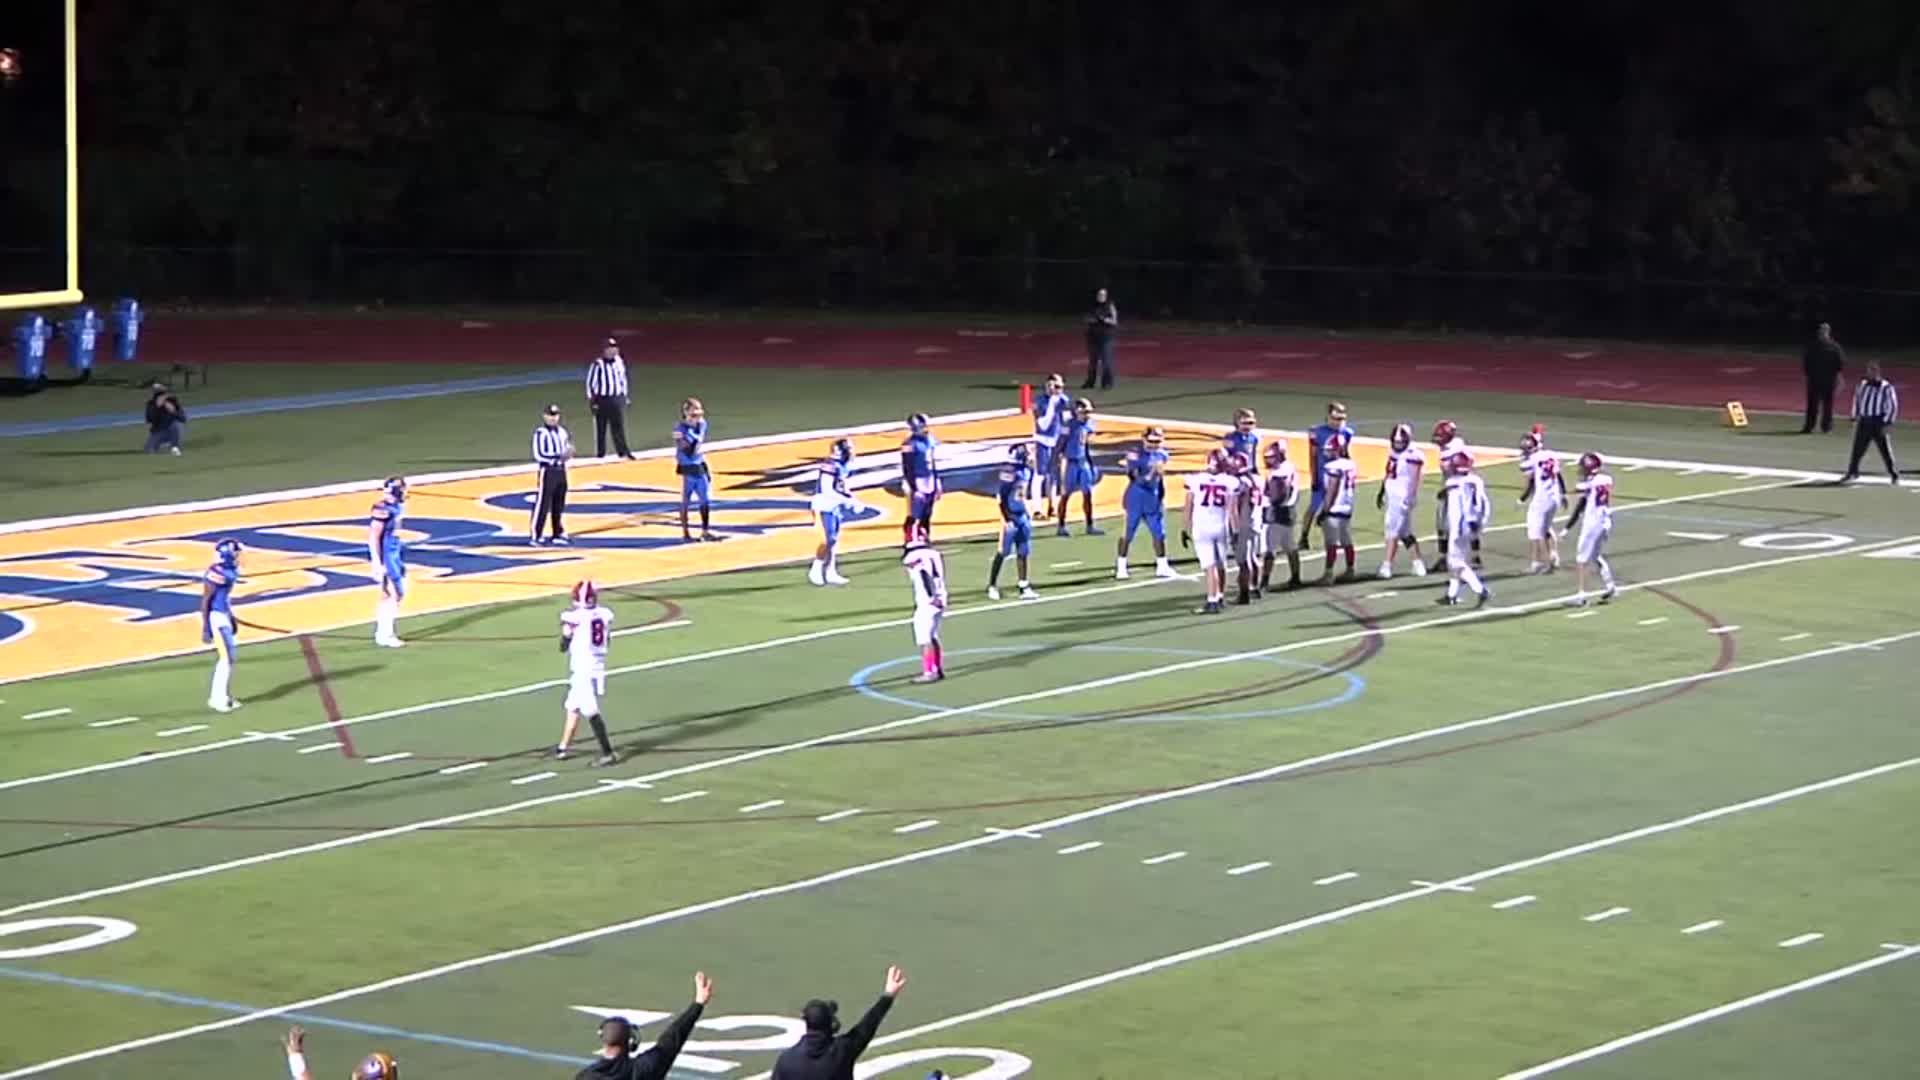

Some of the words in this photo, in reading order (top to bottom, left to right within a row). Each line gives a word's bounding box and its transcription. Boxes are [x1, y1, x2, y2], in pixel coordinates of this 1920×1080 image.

[1199, 483, 1226, 507] 75
[0, 483, 882, 641] ERS
[590, 617, 605, 648] 8
